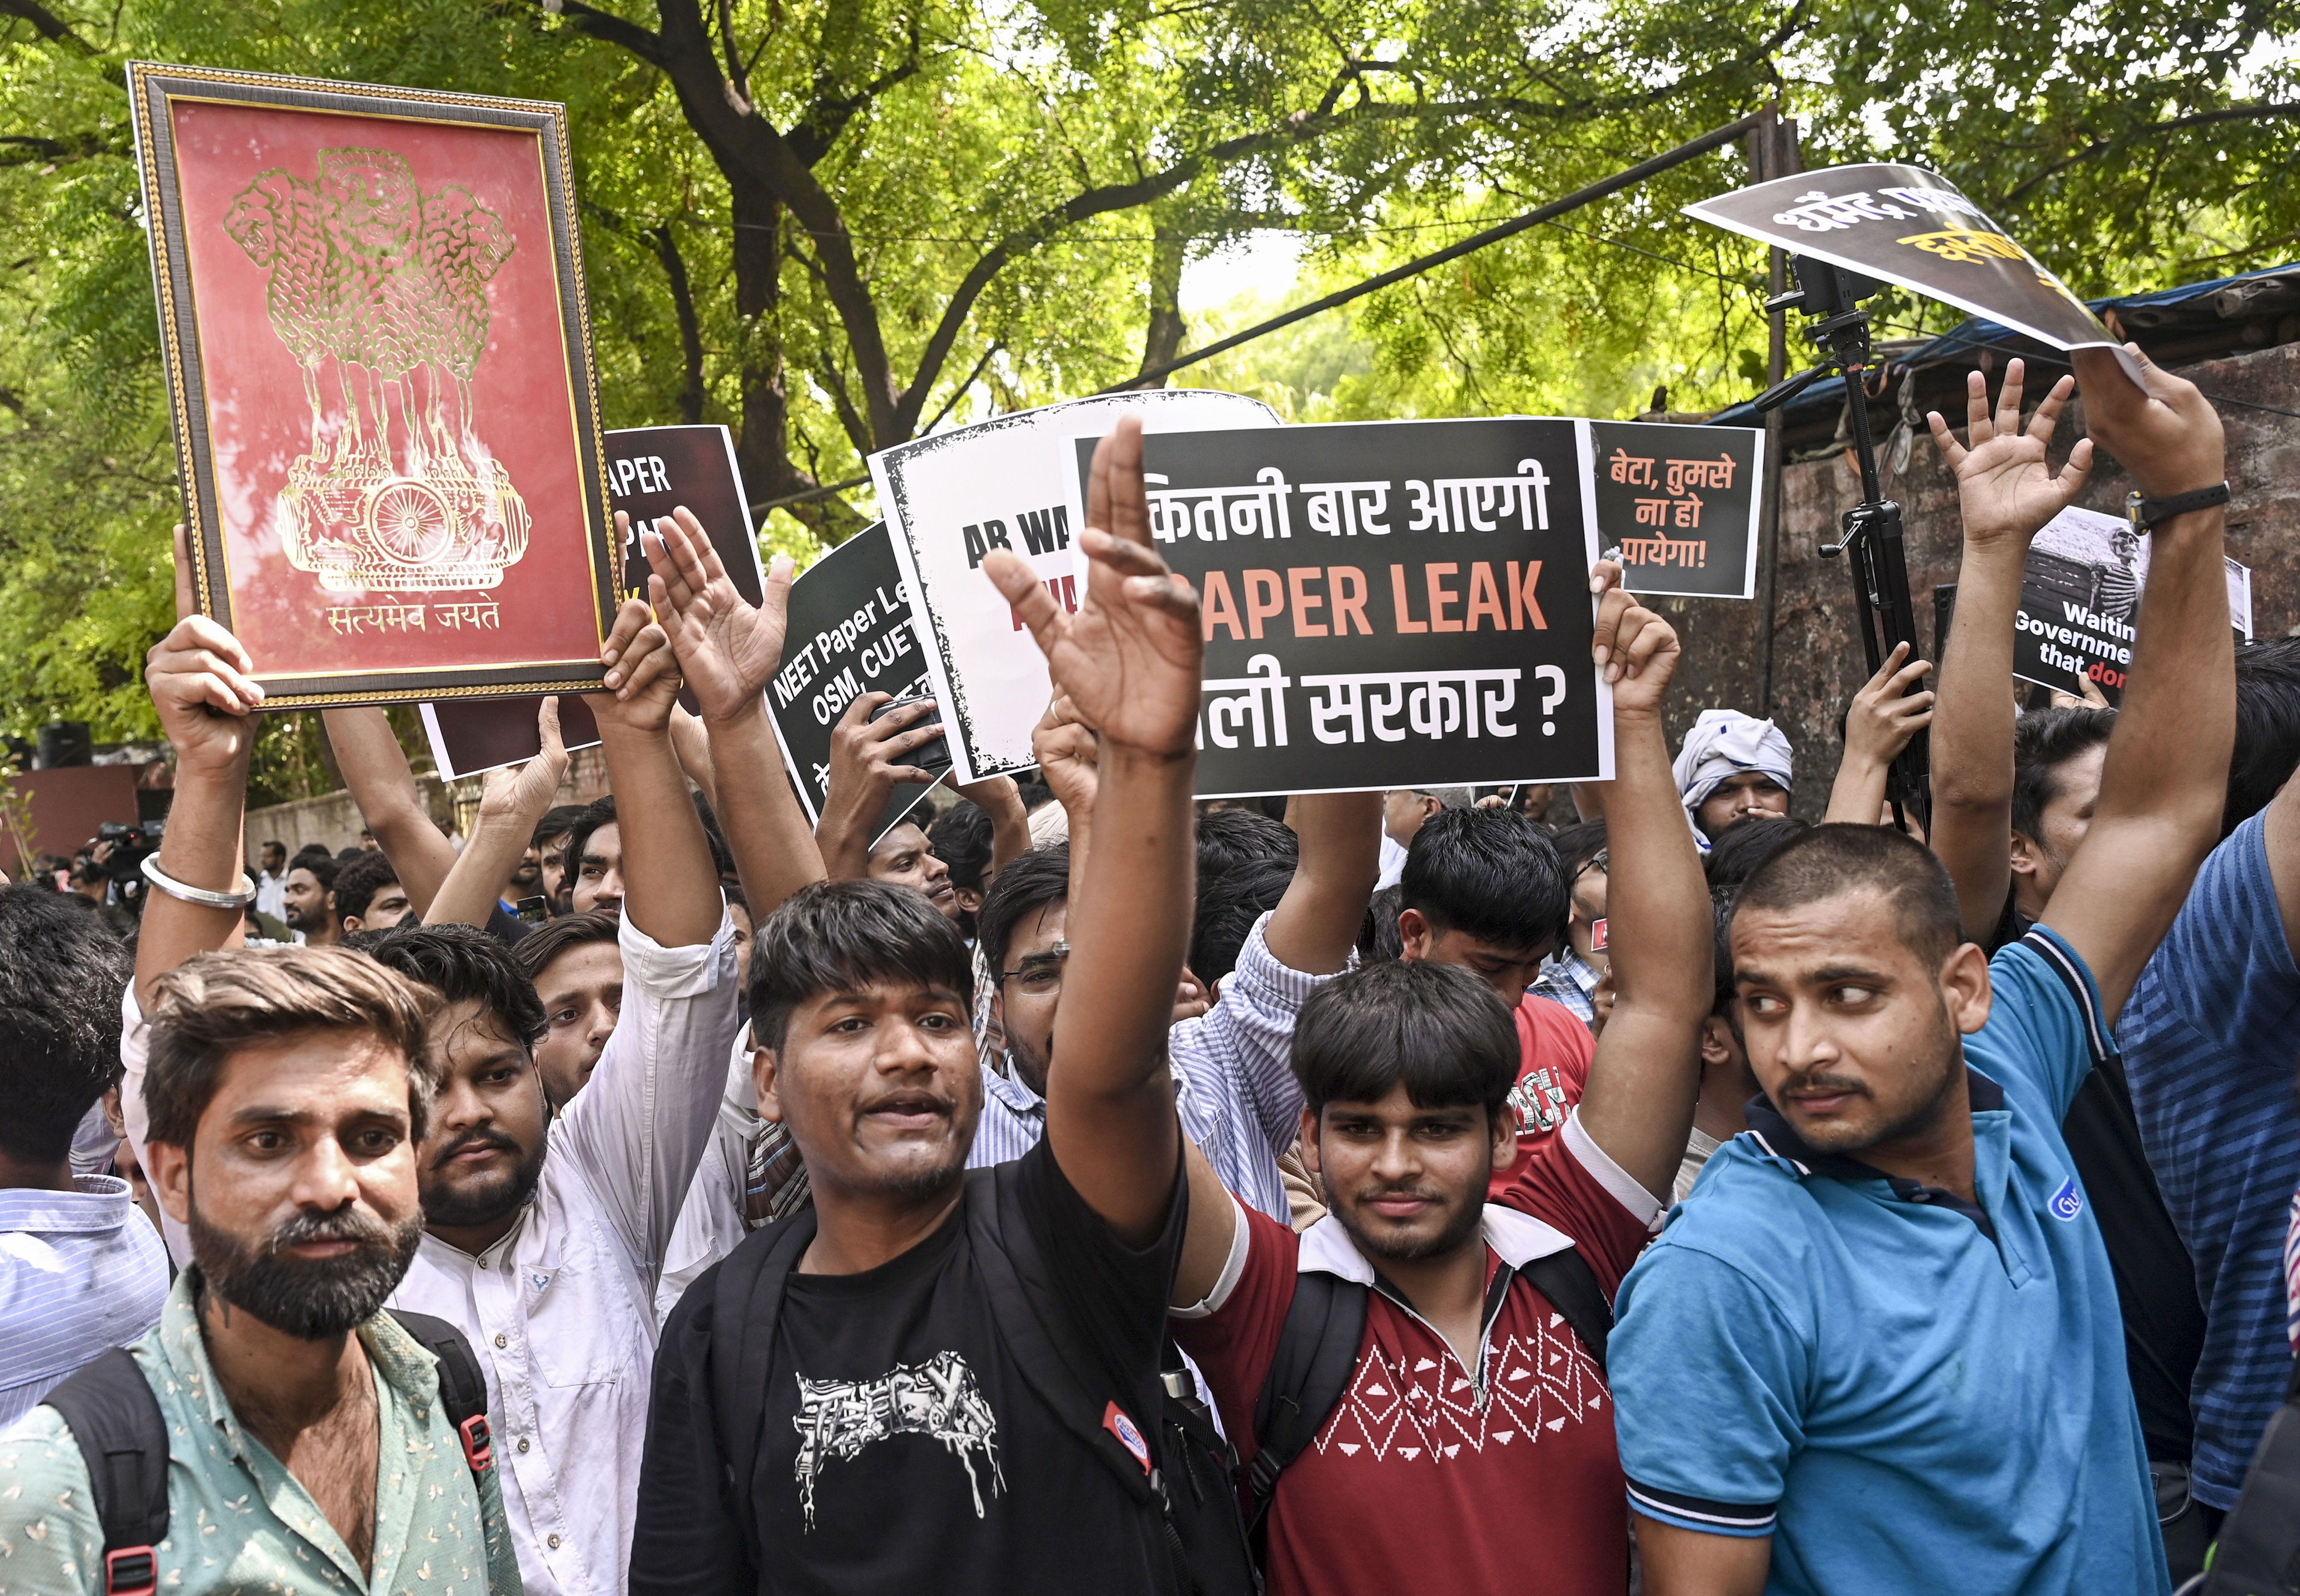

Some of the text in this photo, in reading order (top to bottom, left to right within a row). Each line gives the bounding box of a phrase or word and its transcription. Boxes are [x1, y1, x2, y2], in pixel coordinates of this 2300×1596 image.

[1300, 480, 1390, 536] बार
[1406, 459, 1550, 533] आएगी
[1609, 447, 1736, 496] बेटा, तुमसे
[1634, 492, 1703, 528] ना हो
[1621, 531, 1706, 568] पायेगा!
[326, 591, 500, 635] सत्यमेव जयते
[1170, 560, 1547, 642] APER LEAK
[773, 642, 819, 710] NEET
[816, 600, 877, 664] Paper
[2039, 643, 2085, 676] that
[812, 666, 867, 725] OSM,
[1194, 654, 1566, 751] ली सरकार ?
